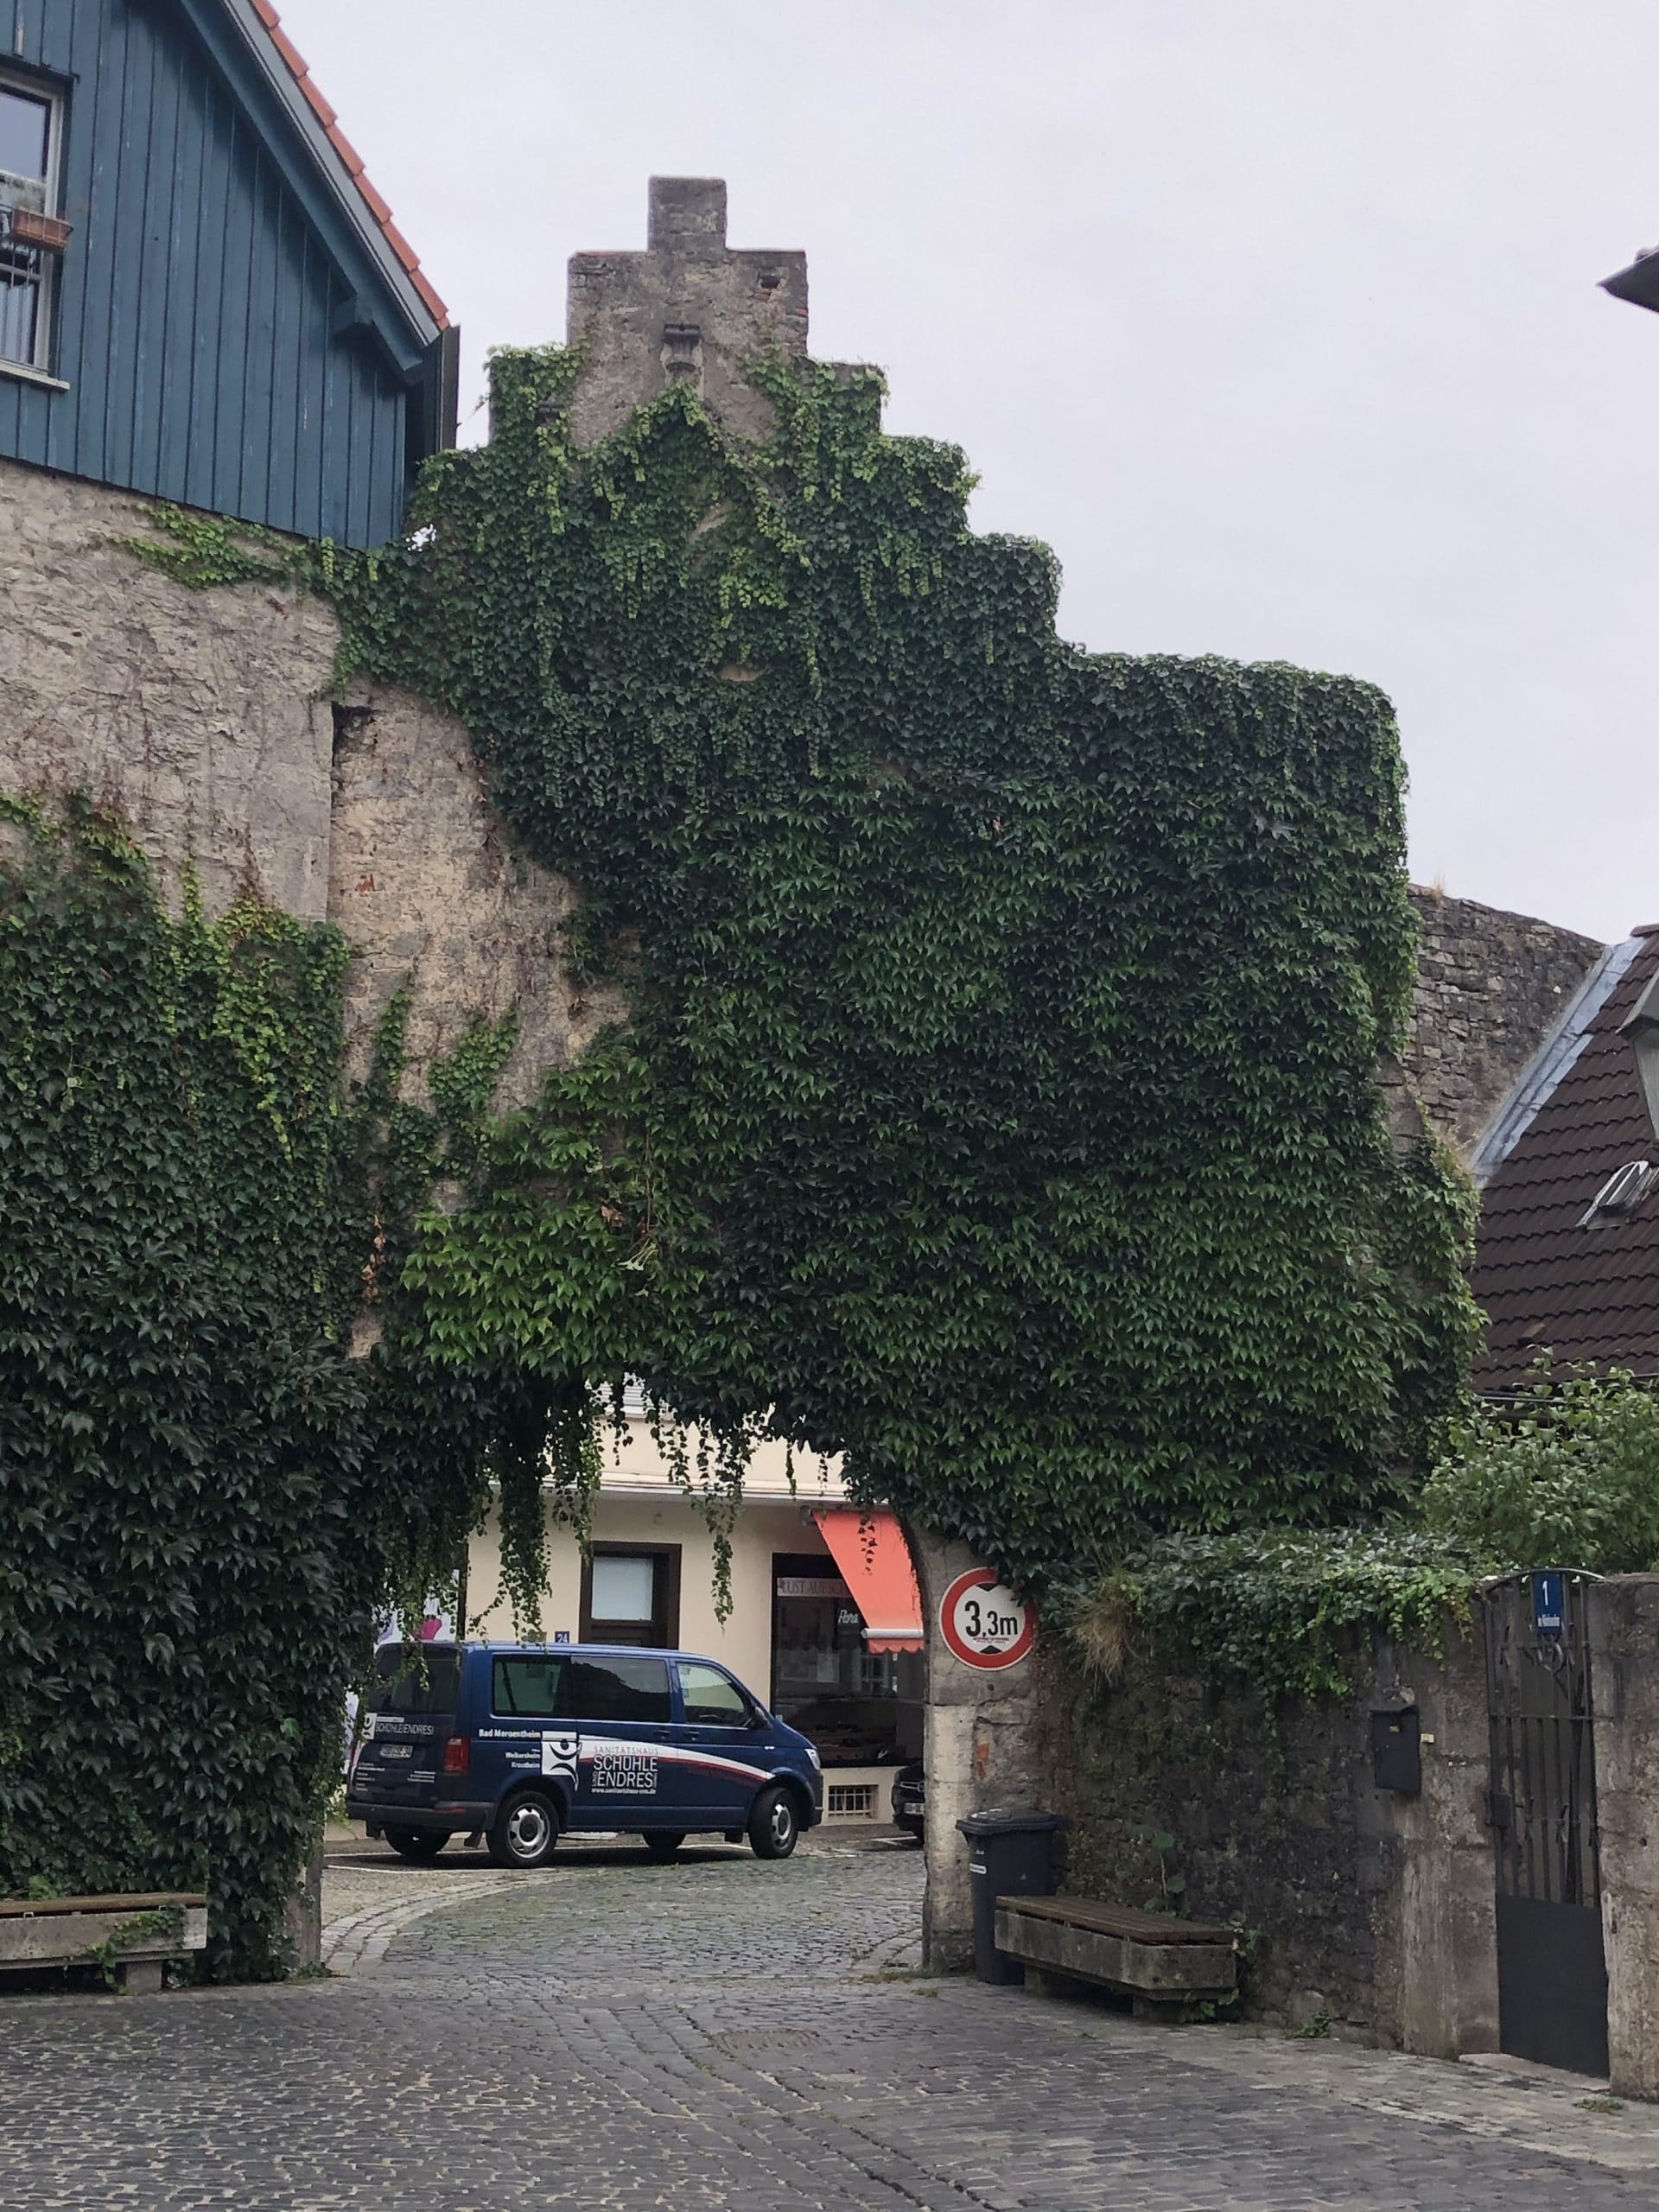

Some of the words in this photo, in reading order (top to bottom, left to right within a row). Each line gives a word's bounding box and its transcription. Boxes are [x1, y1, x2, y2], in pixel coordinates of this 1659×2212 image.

[1542, 1580, 1548, 1606] 1
[964, 1600, 1018, 1637] 3,3m
[557, 1633, 568, 1643] 24
[479, 1729, 493, 1738] Bad
[597, 1771, 653, 1788] ENDRES
